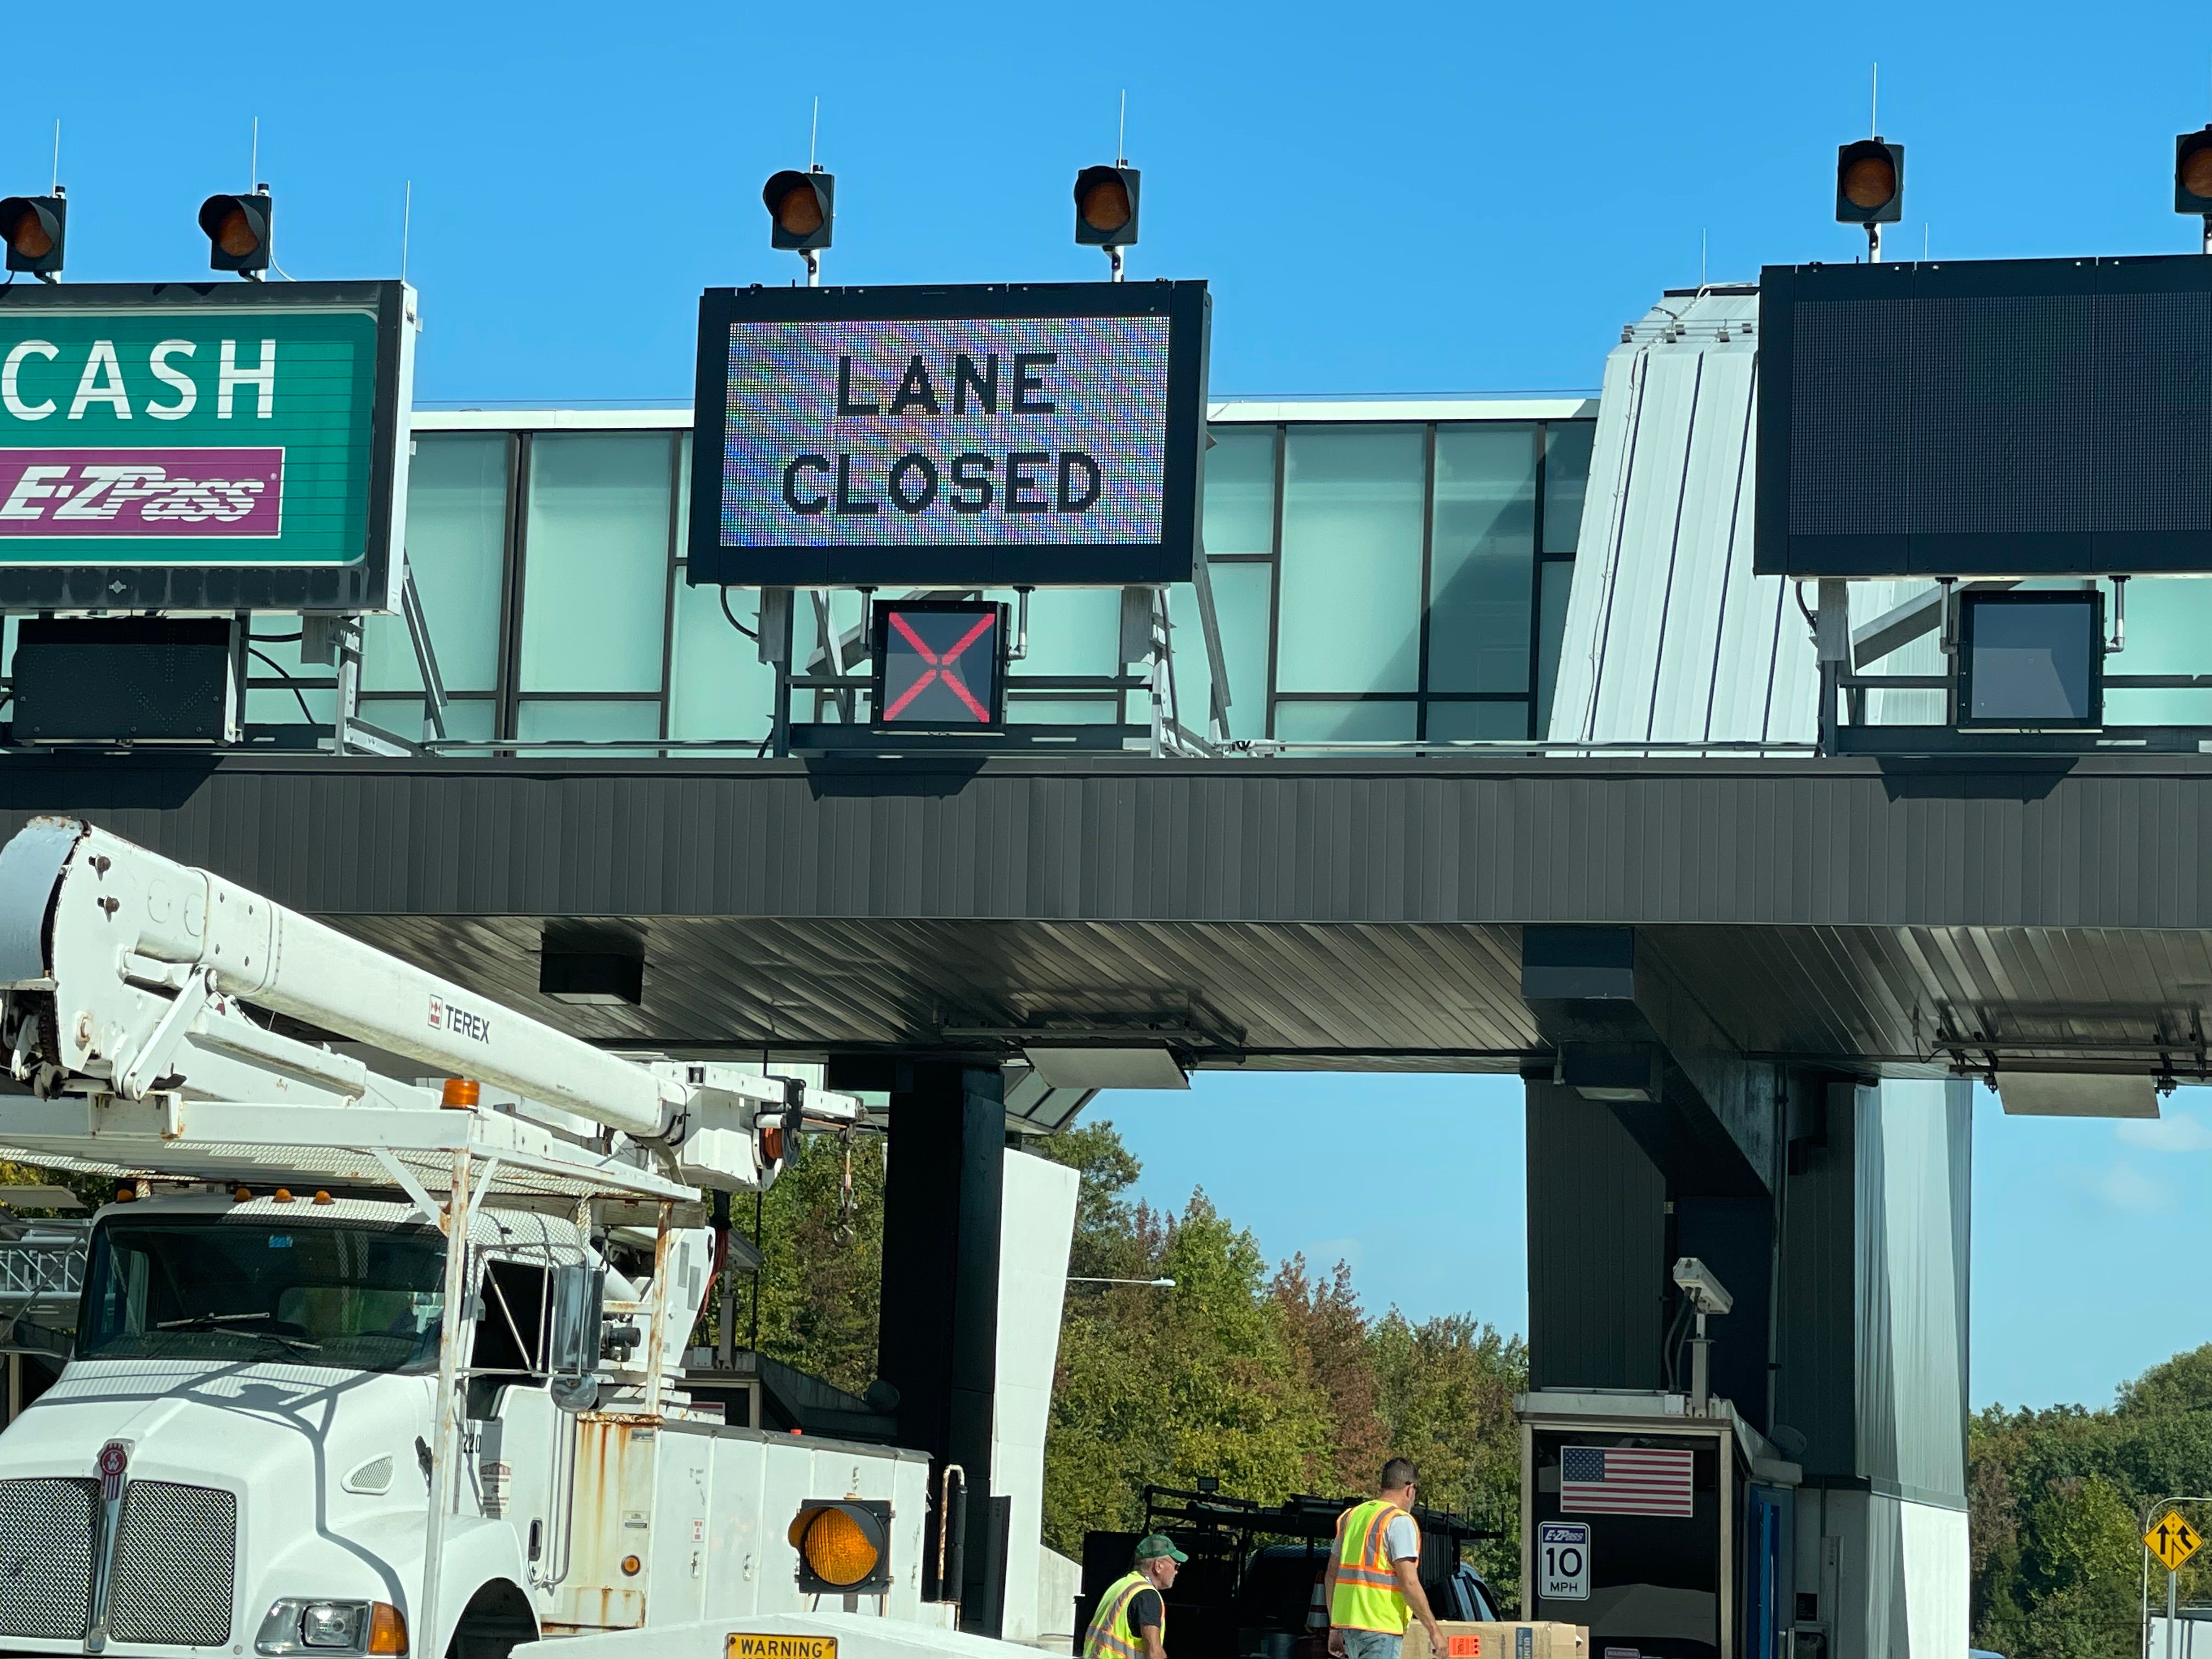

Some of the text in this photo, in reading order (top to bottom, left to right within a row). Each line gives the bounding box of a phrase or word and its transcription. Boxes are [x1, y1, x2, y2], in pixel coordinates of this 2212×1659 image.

[1, 338, 276, 421] CASH
[837, 353, 1058, 416] LANE
[782, 451, 1101, 514] CLOSED
[445, 1004, 490, 1045] TEREX
[1545, 1547, 1582, 1577] 10
[1550, 1581, 1578, 1593] MPH
[741, 1639, 822, 1658] WARNING
